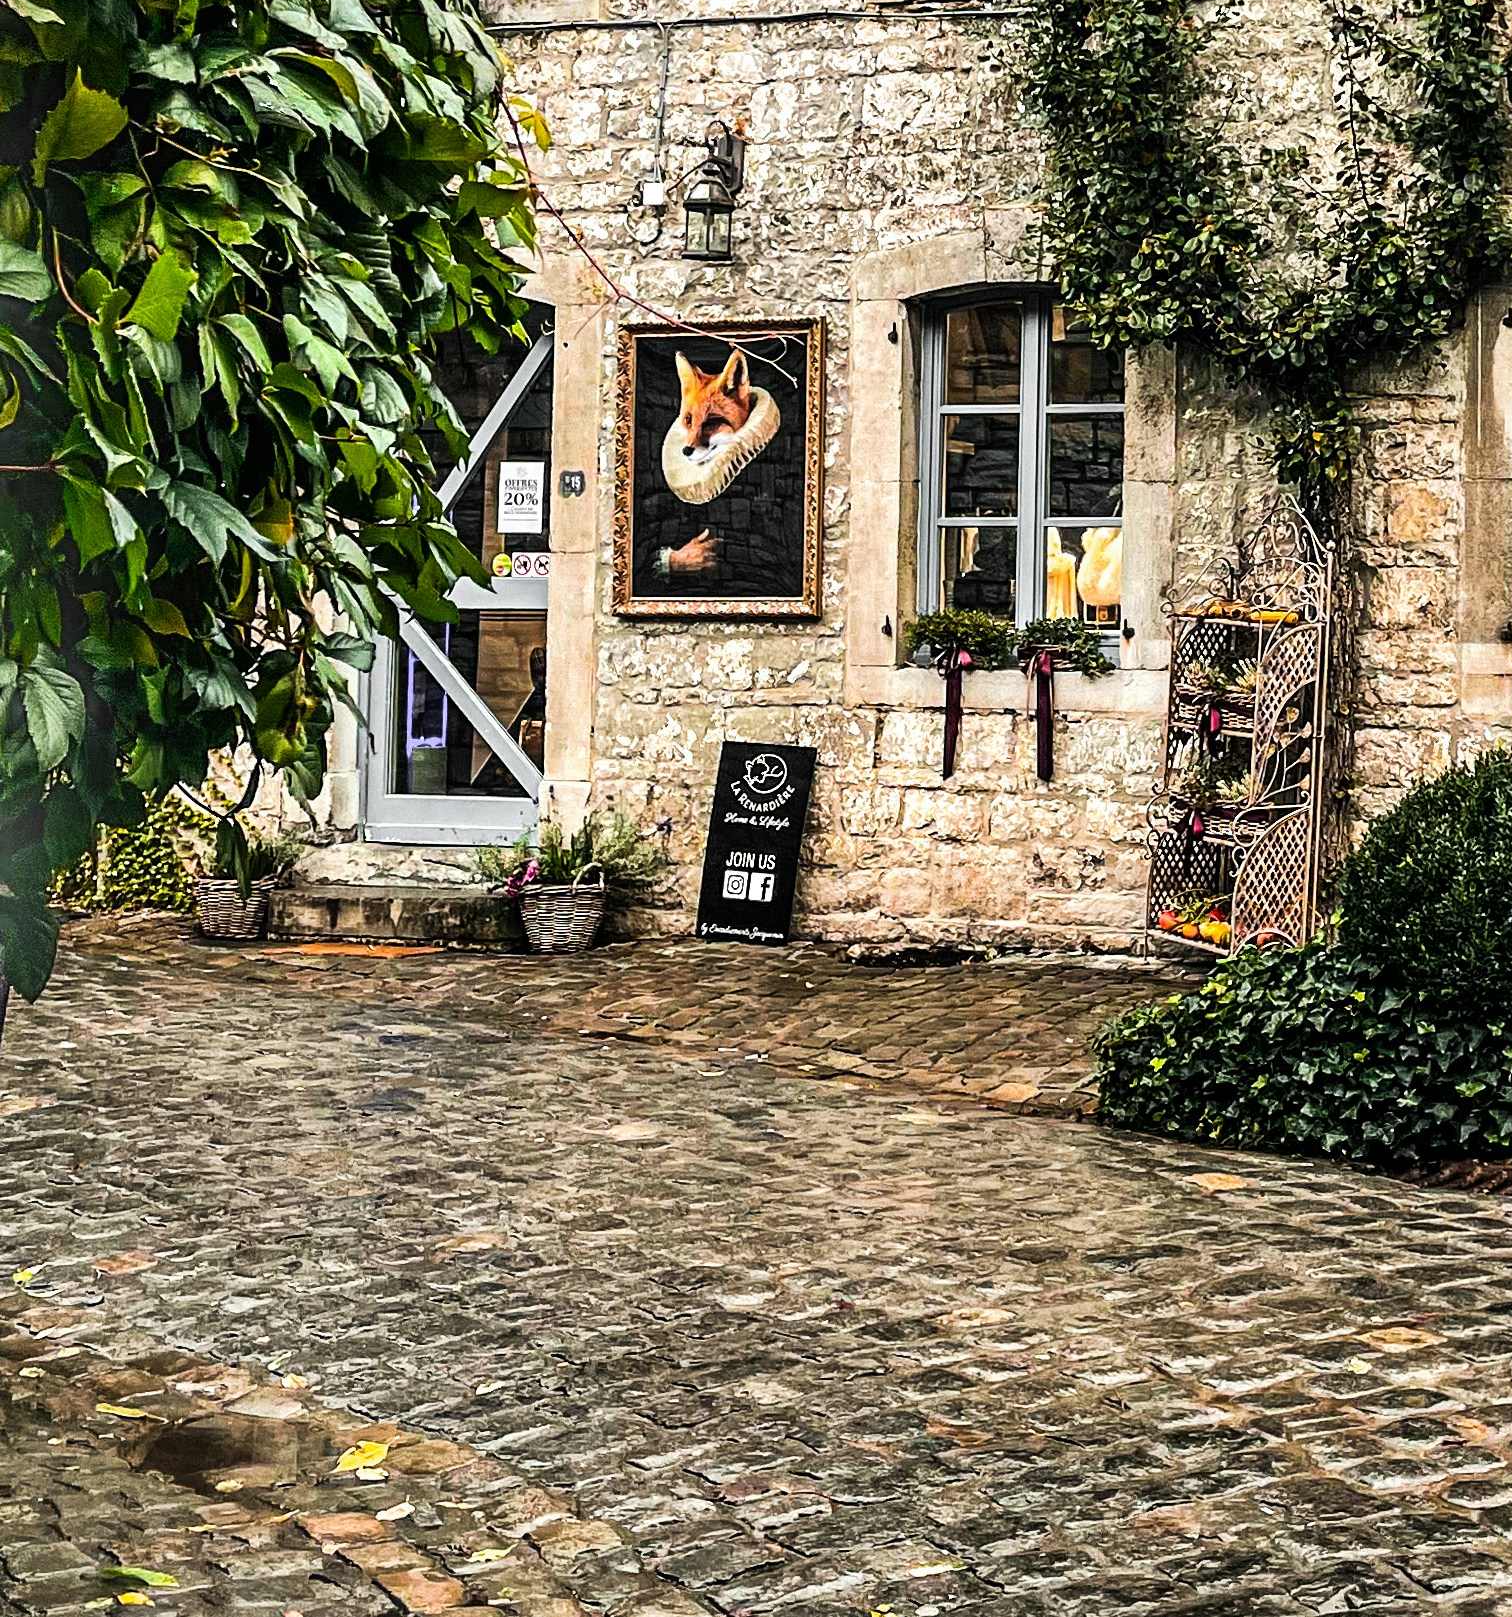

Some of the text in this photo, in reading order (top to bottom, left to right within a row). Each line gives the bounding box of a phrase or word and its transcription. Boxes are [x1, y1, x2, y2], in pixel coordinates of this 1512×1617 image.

[504, 492, 538, 506] 20%
[730, 780, 796, 812] LA RENARDIÈRE
[724, 812, 748, 823] Home
[725, 851, 776, 870] JOIN US
